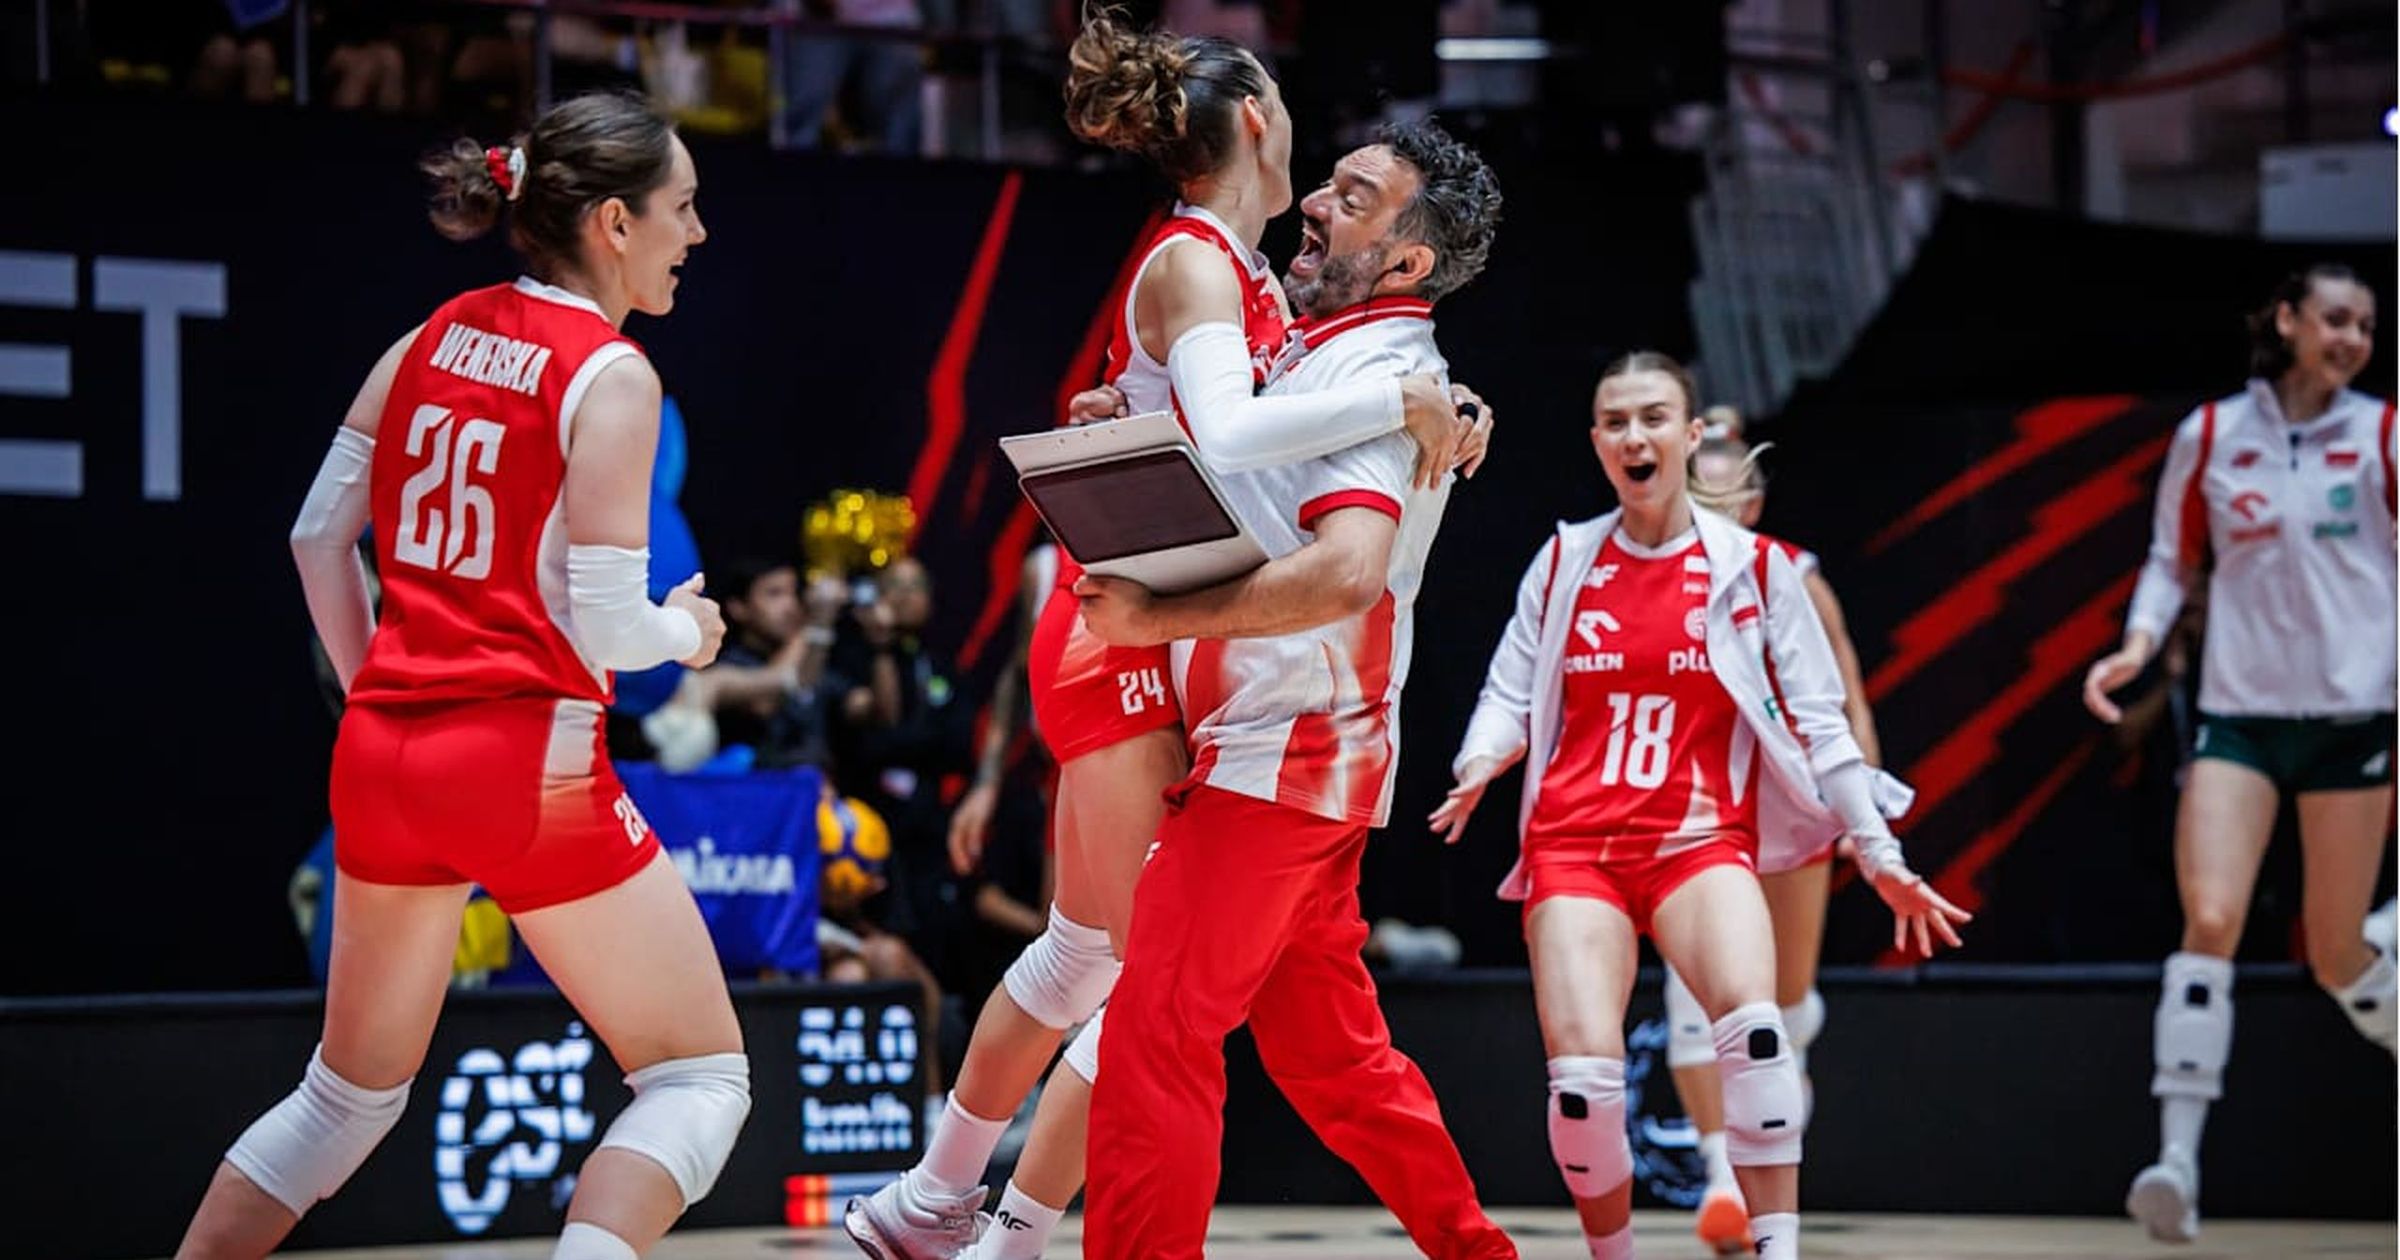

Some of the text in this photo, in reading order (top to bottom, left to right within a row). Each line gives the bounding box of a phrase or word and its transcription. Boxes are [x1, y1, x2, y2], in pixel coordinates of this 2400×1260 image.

[429, 321, 552, 397] WENERSKA
[394, 404, 506, 580] 26
[1118, 666, 1166, 716] 24
[1600, 692, 1677, 790] 18
[798, 1005, 918, 1087] 54.0
